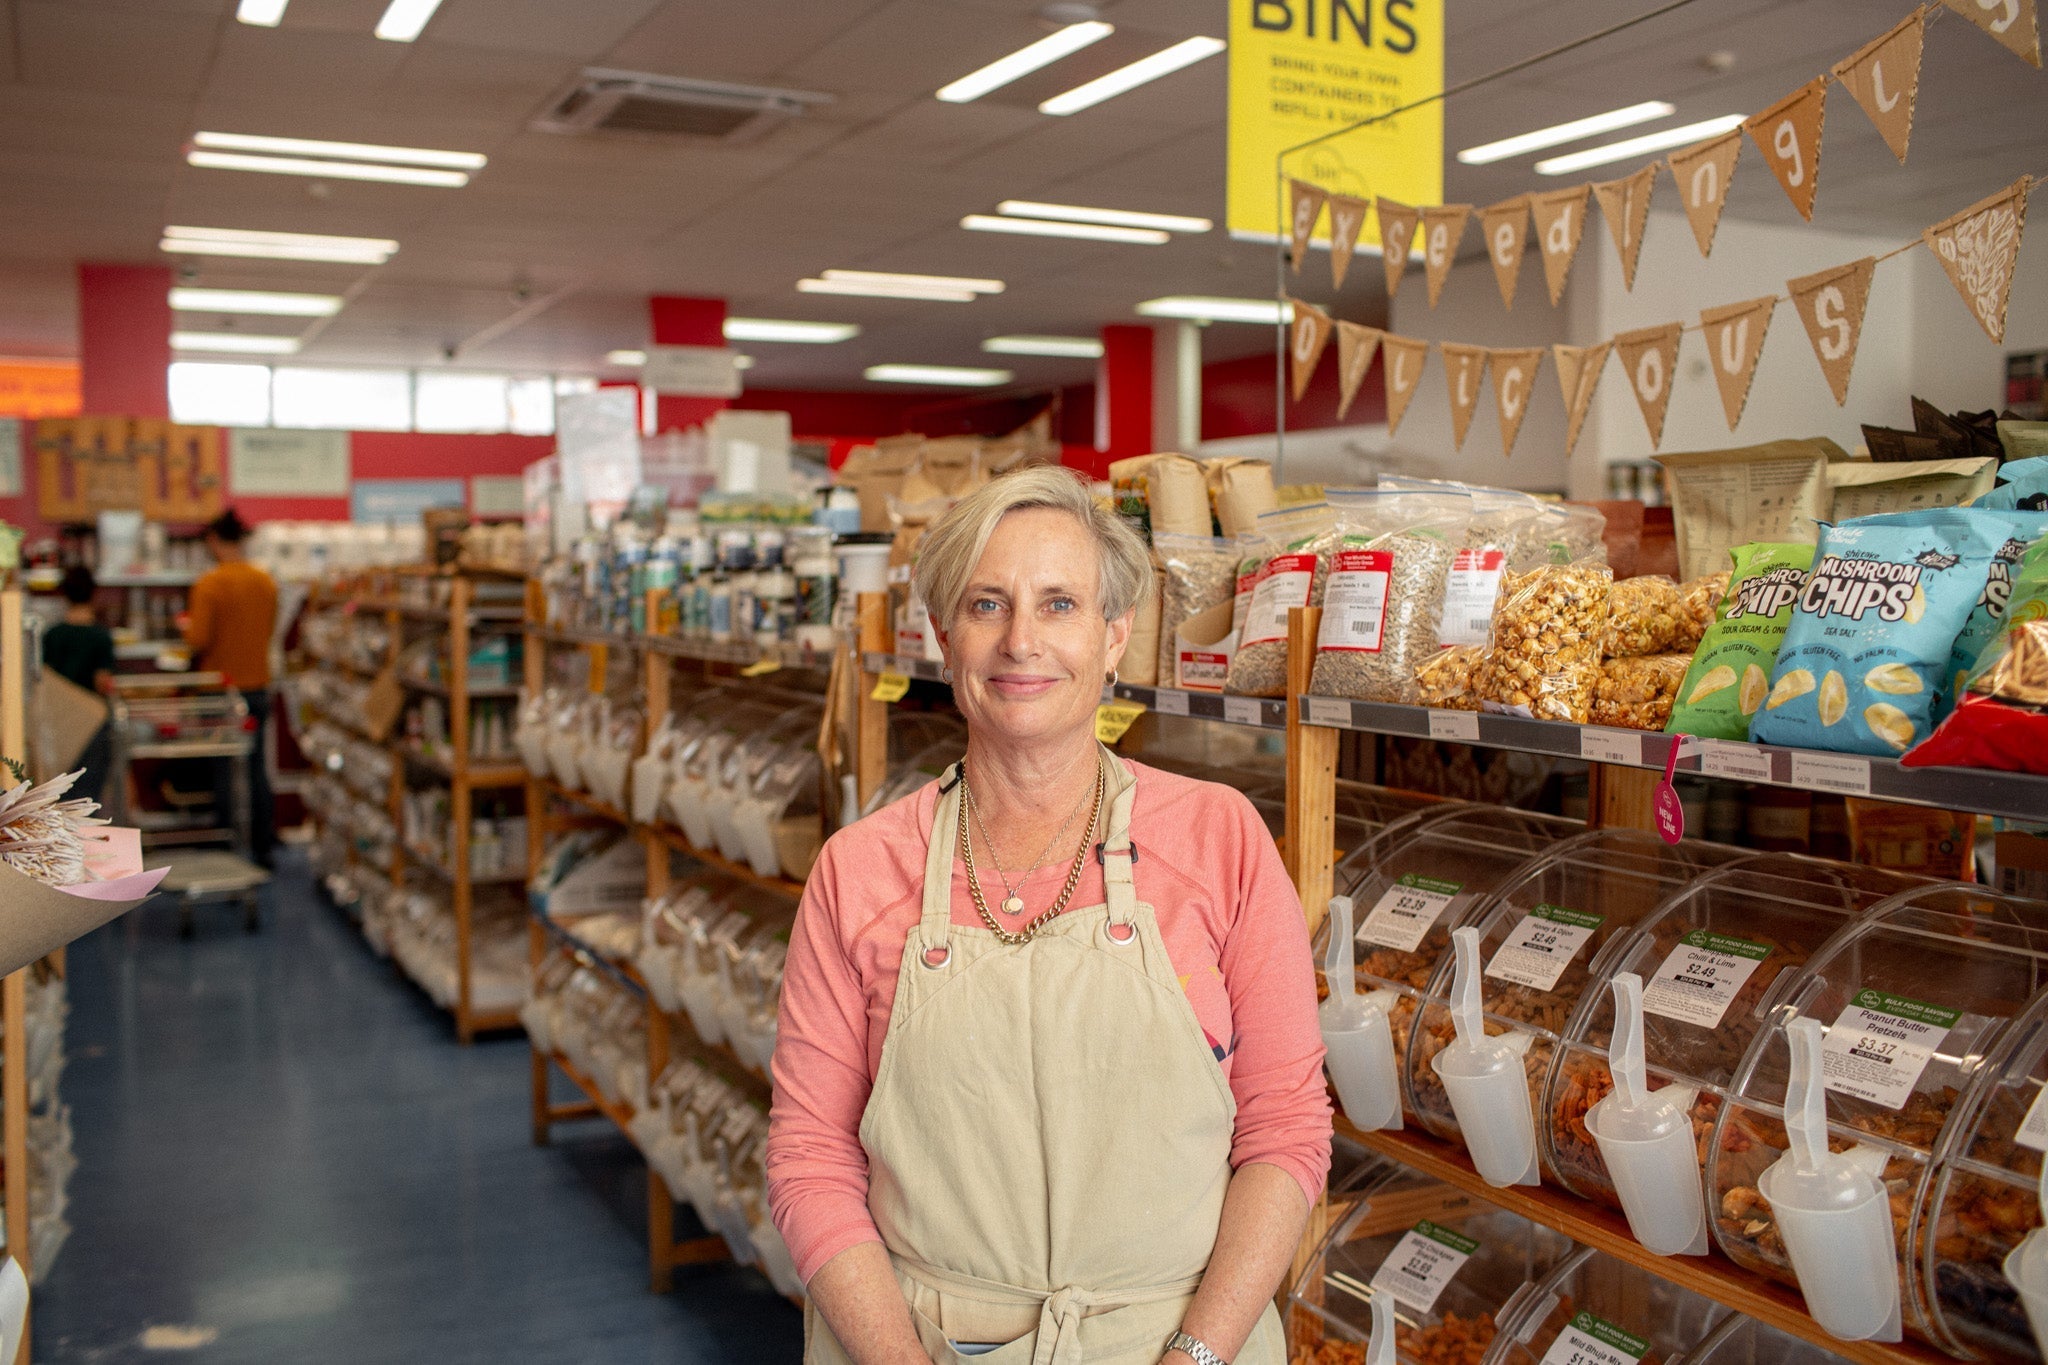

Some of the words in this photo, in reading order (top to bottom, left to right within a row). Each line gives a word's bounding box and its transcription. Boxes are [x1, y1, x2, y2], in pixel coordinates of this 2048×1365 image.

[1252, 0, 1416, 54] BINS
[1816, 556, 1923, 587] MUSHROOM
[1801, 577, 1915, 622] CHIPS
[1722, 626, 1738, 634] SOUR
[1739, 625, 1761, 634] CREAM
[1763, 626, 1770, 634] &
[1824, 627, 1838, 636] SEA
[1839, 628, 1857, 638] SALT
[1701, 650, 1718, 665] VEGAN
[1722, 644, 1743, 653] GLUTEN
[1744, 644, 1760, 656] FREE
[1778, 650, 1797, 665] VEGAN
[1802, 647, 1824, 656] GLUTEN
[1825, 649, 1841, 661] FREE
[1854, 653, 1864, 663] NO
[1865, 648, 1885, 658] PALM
[1886, 649, 1898, 658] OIL
[1659, 806, 1673, 822] NEW
[1663, 820, 1676, 836] LINE
[1531, 932, 1557, 945] $2.49
[1532, 923, 1551, 933] Honey
[1557, 928, 1574, 938] Dijon
[1709, 936, 1725, 944] BULK
[1726, 940, 1742, 948] FOOD
[1742, 944, 1767, 953] SAVINGS
[1687, 952, 1707, 962] Chilli
[1716, 957, 1736, 969] Lime
[1686, 963, 1716, 978] $2.49
[1885, 998, 1902, 1006] BULK
[1903, 1002, 1923, 1011] FOOD
[1925, 1006, 1955, 1019] SAVINGS
[1886, 1005, 1920, 1018] EVERYDAY
[1860, 1009, 1898, 1026] Peanut
[1897, 1019, 1930, 1034] Butter
[1866, 1023, 1908, 1040] Pretzels
[1857, 1037, 1898, 1056] $3.37
[1595, 1322, 1610, 1332] BULK
[1609, 1328, 1623, 1338] FOOD
[1570, 1336, 1586, 1349] Mild
[1585, 1344, 1608, 1360] Bhuja
[1608, 1355, 1622, 1365] Mix
